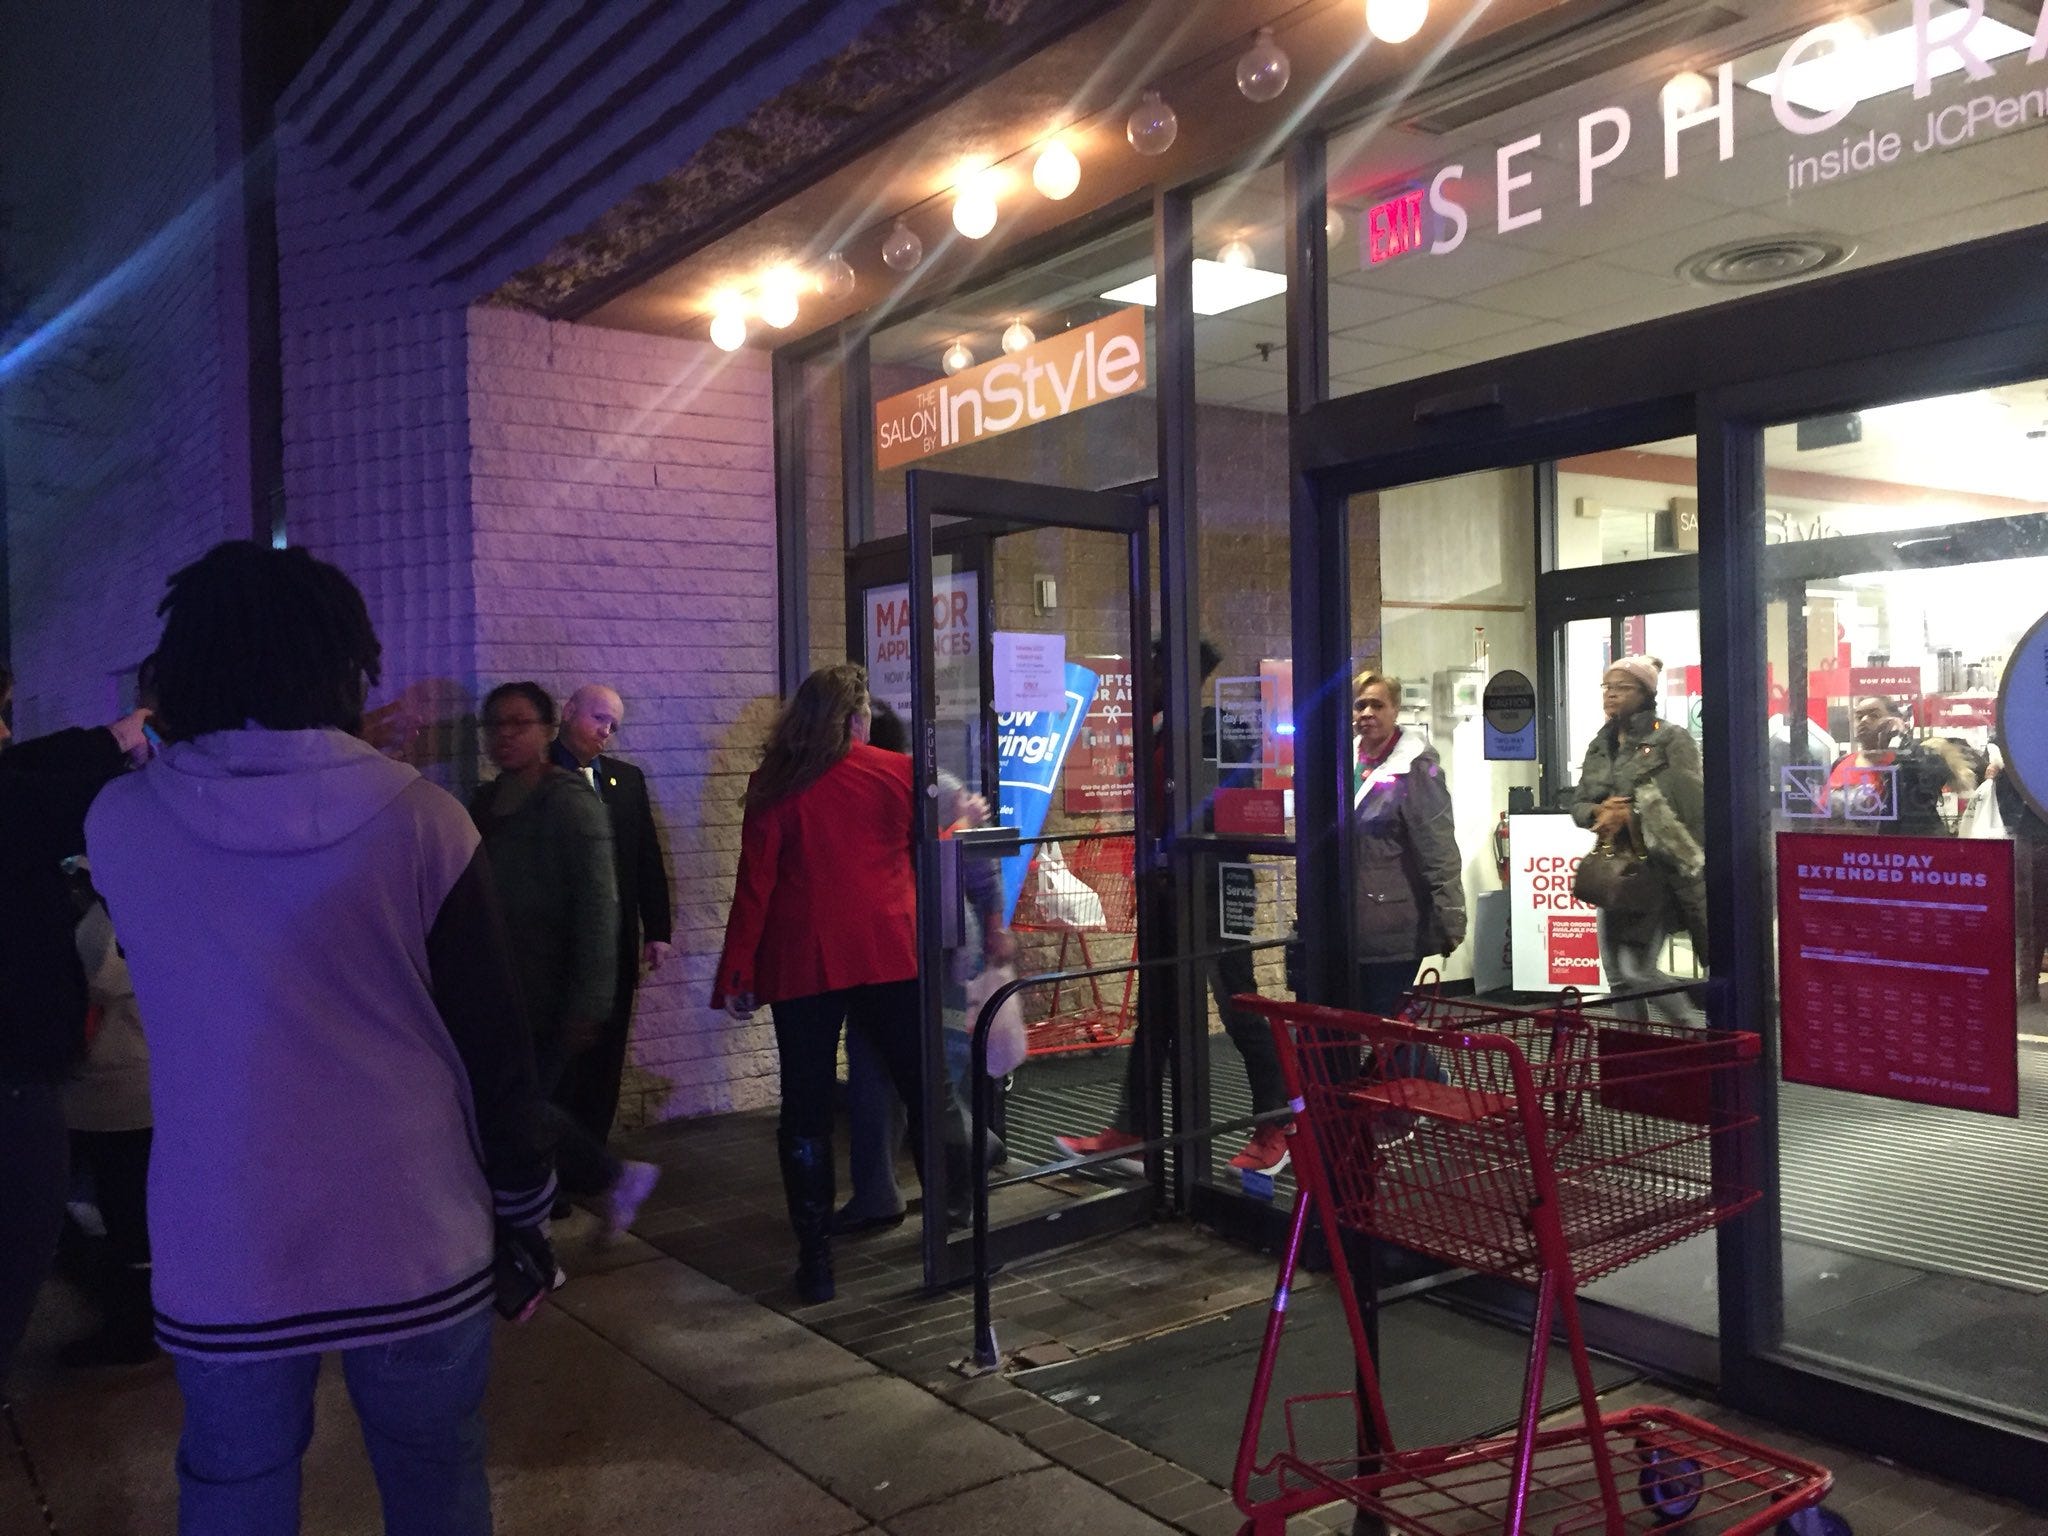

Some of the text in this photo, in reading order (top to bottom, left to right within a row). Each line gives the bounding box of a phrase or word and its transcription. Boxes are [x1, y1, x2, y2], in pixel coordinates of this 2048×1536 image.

[1788, 88, 2048, 191] inside JCPen
[1368, 188, 1425, 266] EXIT
[916, 389, 937, 409] THE
[939, 331, 1141, 447] InStyle
[880, 407, 937, 449] SALON
[923, 436, 937, 452] BY
[875, 591, 969, 638] MAOR
[1100, 674, 1132, 687] IFTS
[998, 729, 1061, 764] ring!
[1524, 856, 1583, 873] JCP.C
[1842, 852, 1934, 868] HOLIDAY
[1532, 875, 1577, 891] ORD
[1797, 864, 1987, 888] EXTENDED HOURS
[1552, 957, 1600, 968] JCP.COM
